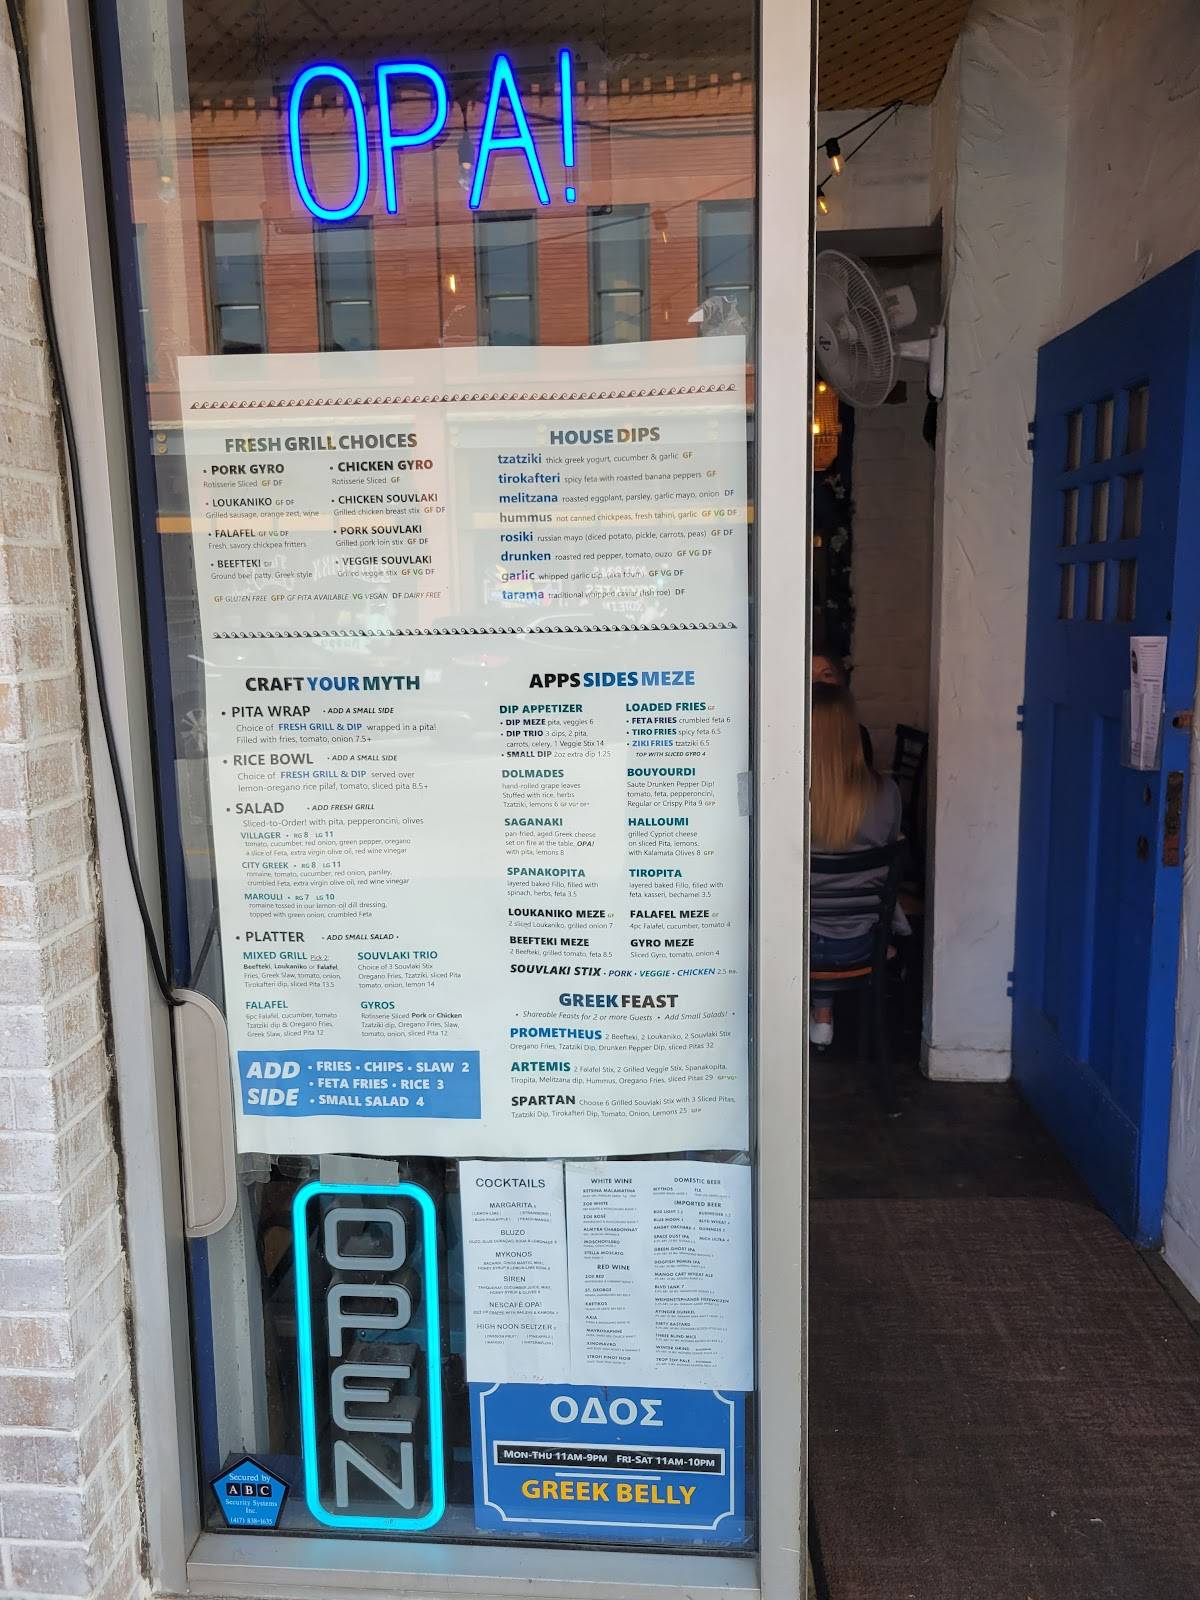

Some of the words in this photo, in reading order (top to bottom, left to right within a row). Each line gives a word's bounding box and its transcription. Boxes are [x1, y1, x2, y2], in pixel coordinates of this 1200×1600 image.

[288, 47, 579, 223] OPA!
[550, 429, 614, 445] HOUSE
[617, 427, 660, 442] DIPS
[225, 438, 281, 452] FRESH
[285, 436, 336, 451] GRILL
[339, 433, 417, 449] CHOICES
[498, 454, 542, 464] tzatziki
[565, 456, 584, 464] greek
[587, 455, 611, 463] yogurt,
[613, 454, 648, 462] cucumber
[659, 452, 678, 461] garlic
[211, 465, 246, 475] PORK
[249, 464, 284, 474] GYRO
[338, 461, 393, 472] CHICKEN
[397, 460, 433, 471] GYRO
[499, 473, 560, 484] tirokafteri
[212, 498, 272, 507] LOUKANIKO
[338, 495, 383, 504] CHICKEN
[386, 494, 438, 503] SOUVLAKI
[499, 493, 558, 503] melitzana
[500, 512, 552, 523] hummus
[215, 529, 255, 538] FALAFEL
[341, 526, 368, 535] PORK
[372, 525, 422, 534] SOUVLAKI
[500, 532, 533, 542] rosiki
[342, 557, 378, 565] VEGGIE
[381, 555, 432, 565] SOUVLAKI
[501, 551, 551, 561] drunken
[217, 559, 261, 568] BEEFTEKI
[501, 570, 535, 582] garlic
[503, 590, 544, 600] tarama
[246, 677, 304, 691] CRAFT
[307, 676, 359, 691] YOUR
[363, 676, 420, 690] MYTH
[530, 673, 580, 688] APPS
[583, 672, 638, 687] SIDES
[641, 671, 695, 686] MEZE
[232, 706, 263, 717] PITA
[267, 705, 311, 717] WRAP
[499, 705, 519, 714] DIP
[522, 704, 583, 713] APPETIZER
[626, 703, 672, 712] LOADED
[675, 702, 706, 711] FRIES
[236, 724, 261, 732] Choice
[264, 724, 274, 732] of
[309, 723, 334, 731] GRILL
[337, 723, 344, 731] &
[347, 723, 362, 731] DIP
[366, 724, 400, 732] wrapped
[403, 723, 411, 731] in
[419, 723, 437, 732] pita!
[233, 755, 265, 766] RICE
[270, 753, 314, 765] BOWL
[502, 770, 564, 778] DOLMADES
[627, 768, 696, 776] BOUYOURDI
[235, 803, 284, 814] SALAD
[505, 818, 563, 826] SAGANAKI
[628, 818, 689, 826] HALLOUMI
[507, 867, 585, 877] SPANAKOPITA
[629, 869, 682, 878] TIROPITA
[244, 893, 283, 901] MAROULI
[508, 908, 573, 918] LOUKANIKO
[576, 910, 605, 918] MEZE
[630, 910, 676, 918] FALAFEL
[679, 910, 709, 918] MEZE
[245, 932, 305, 943] PLATTER
[510, 936, 557, 945] BEEFTEKI
[560, 937, 589, 946] MEZE
[631, 939, 662, 947] GYRO
[665, 939, 694, 947] MEZE
[243, 952, 277, 960] MIXED
[280, 951, 307, 960] GRILL
[357, 951, 410, 960] SOUVLAKI
[413, 951, 438, 959] TRIO
[510, 964, 571, 976] SOUVLAKI
[574, 967, 601, 976] STIX
[677, 968, 715, 976] CHICKEN
[246, 1001, 288, 1009] FALAFEL
[361, 1001, 395, 1009] GYROS
[559, 993, 618, 1008] GREEK
[621, 995, 678, 1008] FEAST
[510, 1028, 602, 1040] PROMETHEUS
[247, 1062, 300, 1079] ADD
[316, 1062, 351, 1072] FRIES
[364, 1062, 403, 1072] CHIPS
[416, 1063, 454, 1072] SLAW
[462, 1063, 469, 1072] 2
[511, 1062, 571, 1072] ARTEMIS
[318, 1079, 349, 1089] FETA
[353, 1079, 388, 1089] FRIES
[401, 1080, 429, 1090] RICE
[437, 1080, 444, 1090] 3
[247, 1088, 299, 1106] SIDE
[319, 1095, 361, 1105] SMALL
[365, 1096, 409, 1106] SALAD
[416, 1097, 424, 1106] 4
[512, 1095, 575, 1107] SPARTAN
[476, 1178, 546, 1188] COCKTAILS
[324, 1208, 416, 1509] OPEN
[550, 1396, 663, 1426] ΟΔΟΣ
[504, 1450, 552, 1460] MON-THU
[555, 1452, 608, 1462] 11AM-9PM
[616, 1454, 652, 1464] FRI-SAT
[655, 1456, 715, 1466] 11AM-10PM
[229, 1473, 258, 1481] Secured
[262, 1474, 271, 1482] by
[522, 1479, 609, 1502] GREEK
[617, 1483, 696, 1504] BELLY
